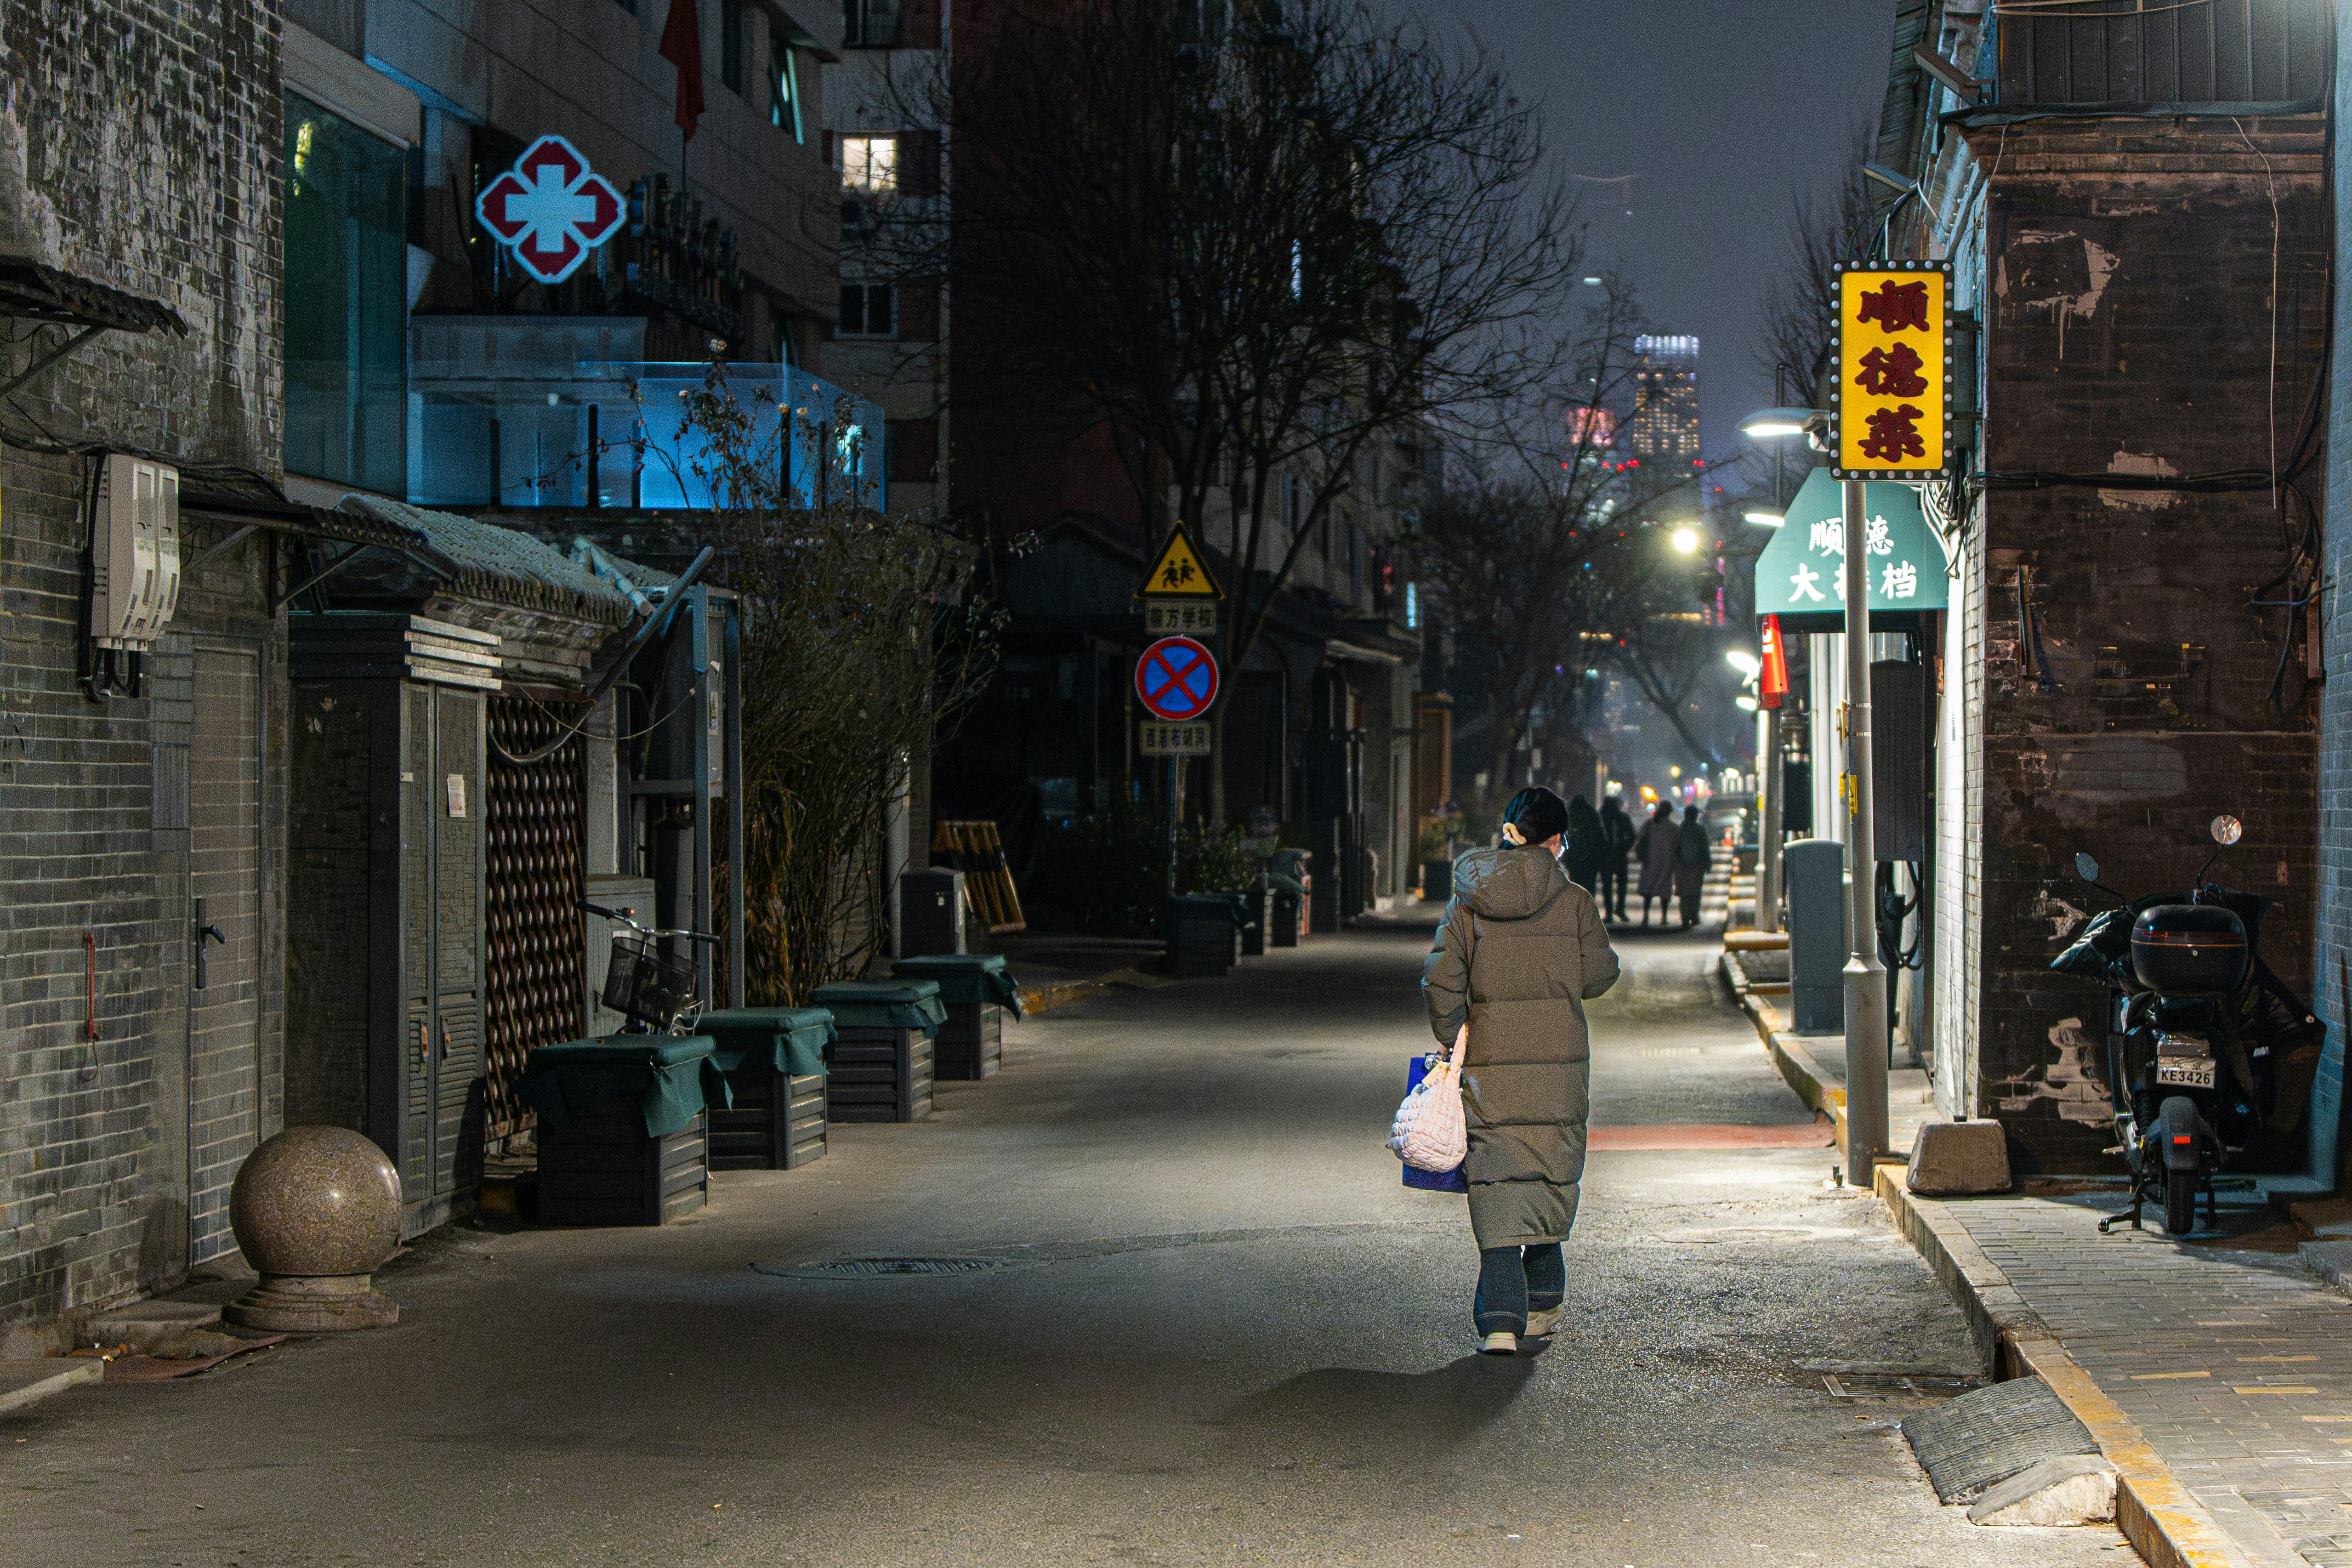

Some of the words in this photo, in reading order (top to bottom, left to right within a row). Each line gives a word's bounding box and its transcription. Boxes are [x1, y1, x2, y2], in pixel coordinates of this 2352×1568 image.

[1809, 514, 1895, 557] 顺德
[1151, 606, 1211, 628] 前方学校
[2161, 1069, 2210, 1084] KE3426
